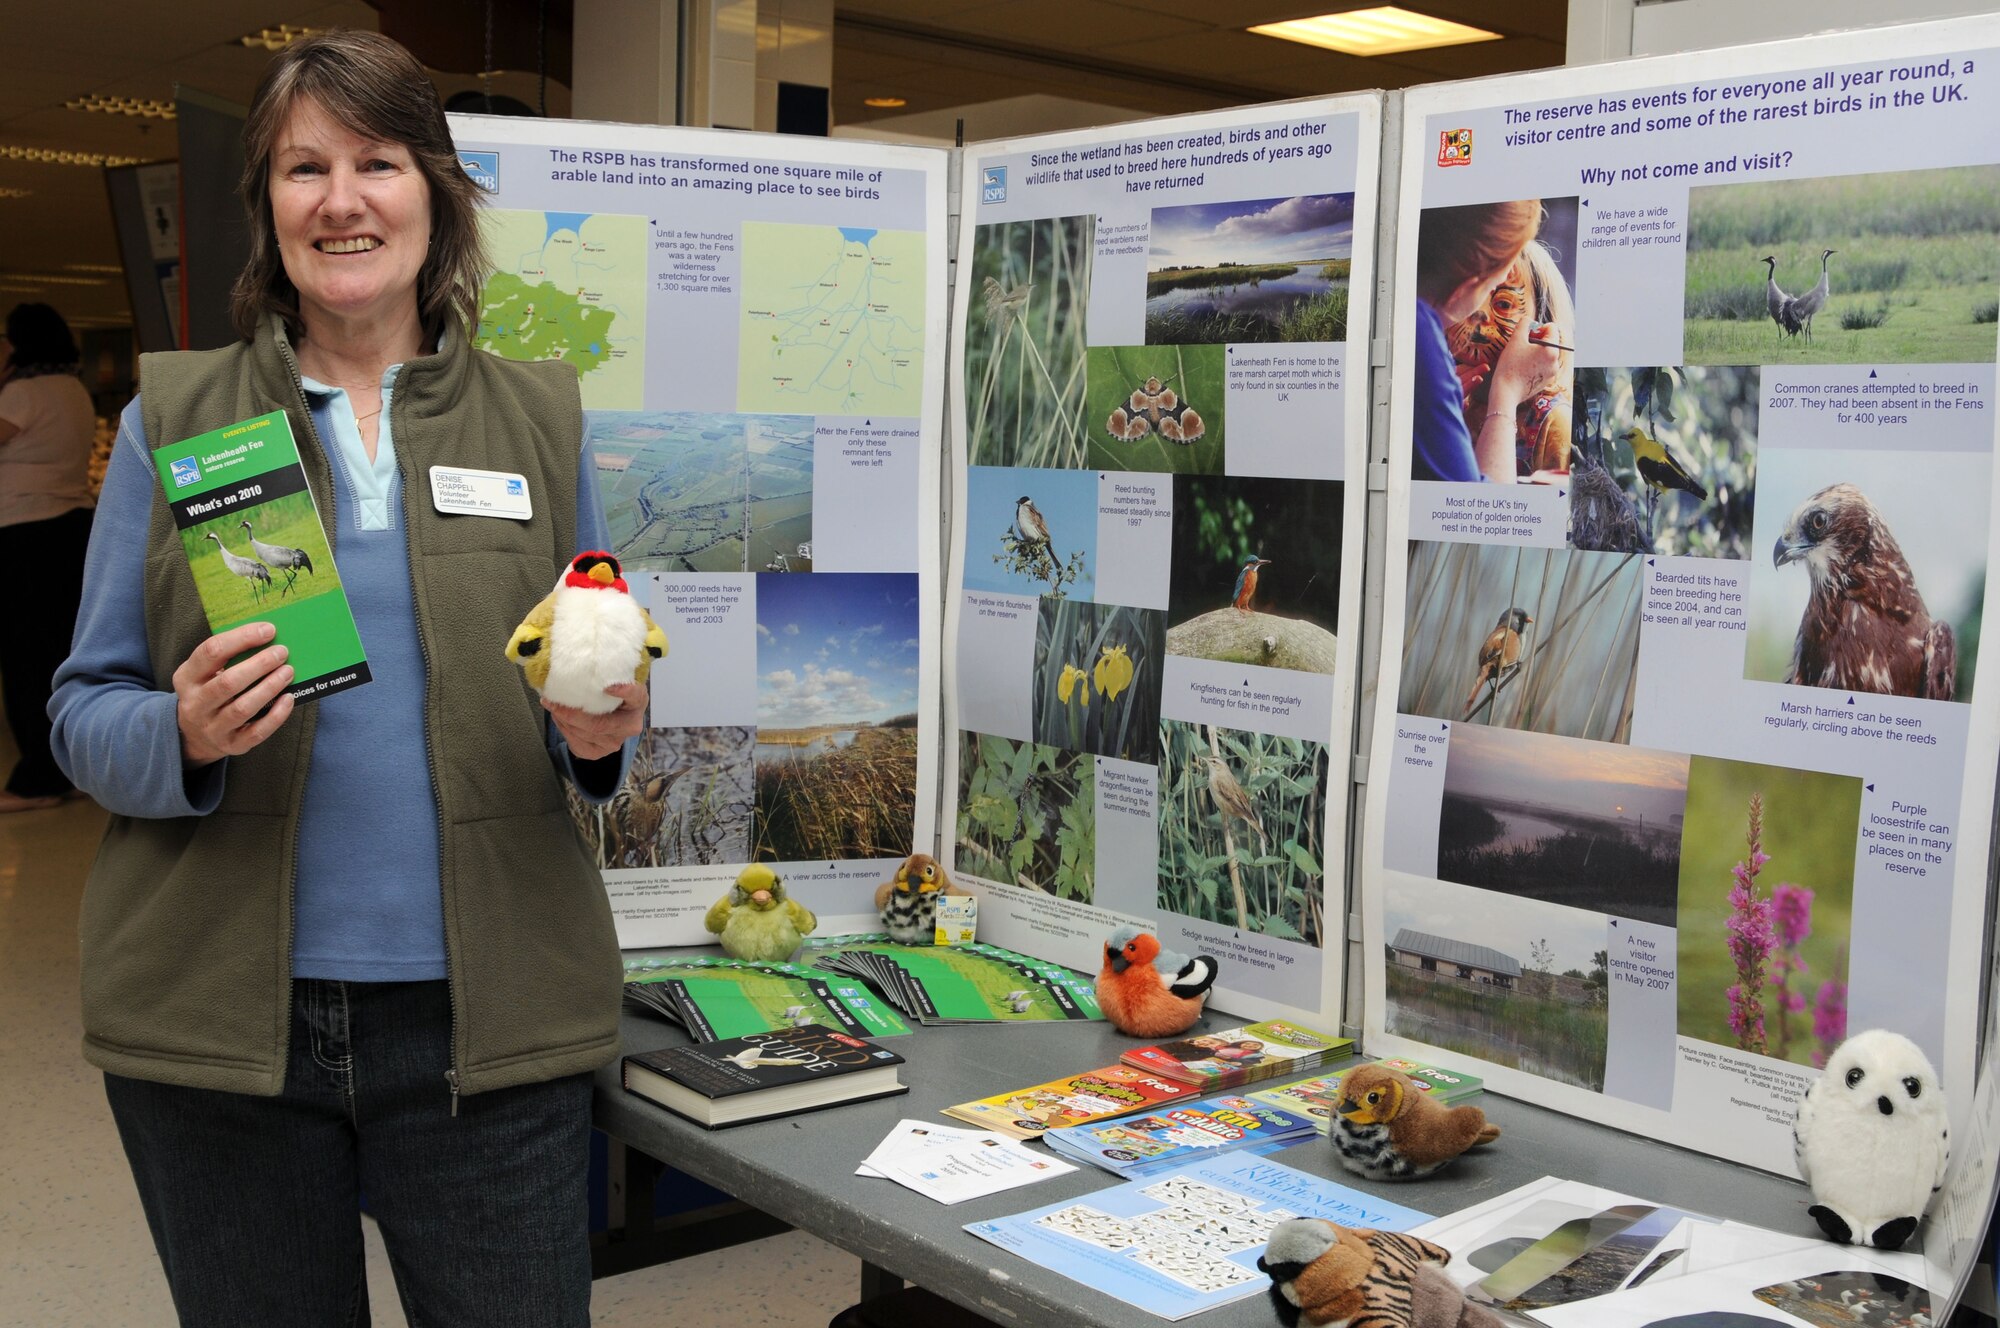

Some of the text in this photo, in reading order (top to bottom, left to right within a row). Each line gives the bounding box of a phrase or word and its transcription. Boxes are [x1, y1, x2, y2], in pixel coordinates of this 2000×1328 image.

[1504, 61, 1974, 124] The reserve has events for everyone all year round, a
[1505, 84, 1967, 146] visitor centre and some of the rarest birds in the UK.
[1031, 123, 1326, 167] Since the wetland has been created, birds and other
[549, 149, 882, 182] The RSPB has transformed one square mile of
[1025, 144, 1332, 185] wildlife that used to breed here hundreds of years ago
[1581, 151, 1793, 186] Why not come and visit?
[474, 176, 495, 190] PB
[551, 169, 880, 199] arable land into an amazing place to see birds
[1126, 172, 1204, 192] have returned
[985, 188, 1005, 200] RSPB
[1774, 382, 1978, 395] Common cranes attempted to breed in
[1769, 397, 1984, 410] 2007. They had been absent in the Fens
[223, 420, 270, 438] EVENTS LISTING
[1838, 412, 1908, 426] for 400 years
[202, 440, 263, 464] Lakenheath Fen
[205, 458, 245, 473] nature reserve
[176, 471, 200, 486] RSPB
[436, 475, 463, 483] DENISE
[437, 482, 475, 492] CHAPPELL
[186, 484, 262, 516] What's on 2010
[439, 490, 469, 498] Volunteer
[294, 673, 356, 698] oices for nature
[1190, 683, 1227, 695] Kingfishers
[1242, 689, 1252, 698] be
[1253, 692, 1270, 700] seen
[1272, 695, 1301, 707] regularly
[1200, 695, 1290, 715] hunting for fish in the pond
[1627, 935, 1656, 949] A new
[1629, 950, 1656, 962] visitor
[1610, 958, 1673, 980] centre opened
[1614, 970, 1670, 990] in May 2007
[741, 1034, 838, 1072] GUIDE
[775, 1026, 870, 1064] BIRD
[1679, 1045, 1697, 1055] Picture
[1719, 1056, 1733, 1065] Face
[1734, 1060, 1757, 1071] painting,
[1759, 1066, 1783, 1076] common
[1785, 1073, 1804, 1082] cranes
[1138, 1078, 1179, 1093] Free
[1418, 1068, 1460, 1084] Free
[1730, 1097, 1780, 1116] Registered charity
[1172, 1112, 1242, 1139] wildlife
[1208, 1109, 1292, 1130] fun Free
[1766, 1115, 1791, 1126] Scotland
[946, 1154, 981, 1174] Programme
[1251, 1163, 1298, 1184] THE
[1200, 1169, 1334, 1221] GUIDE TO WETLAND
[1233, 1167, 1390, 1224] INDEPENDENT
